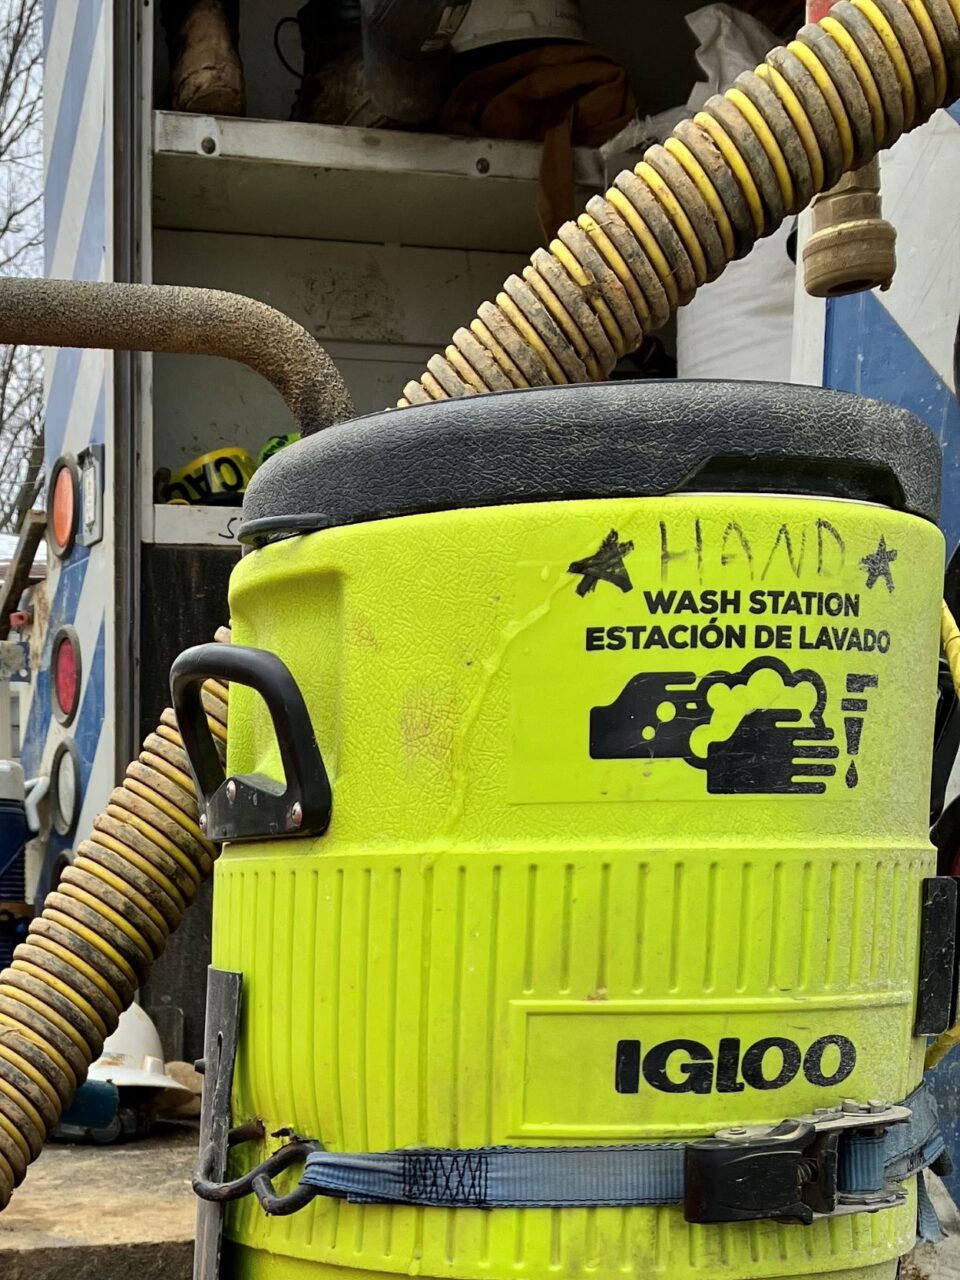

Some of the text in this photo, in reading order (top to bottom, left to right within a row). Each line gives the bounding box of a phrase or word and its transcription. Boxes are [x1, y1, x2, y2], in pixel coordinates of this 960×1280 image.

[658, 517, 846, 584] HAND
[643, 589, 860, 618] WASH STATION
[585, 618, 891, 655] ESTACIÓN DE LAVADO
[615, 1034, 857, 1094] IGLOO
